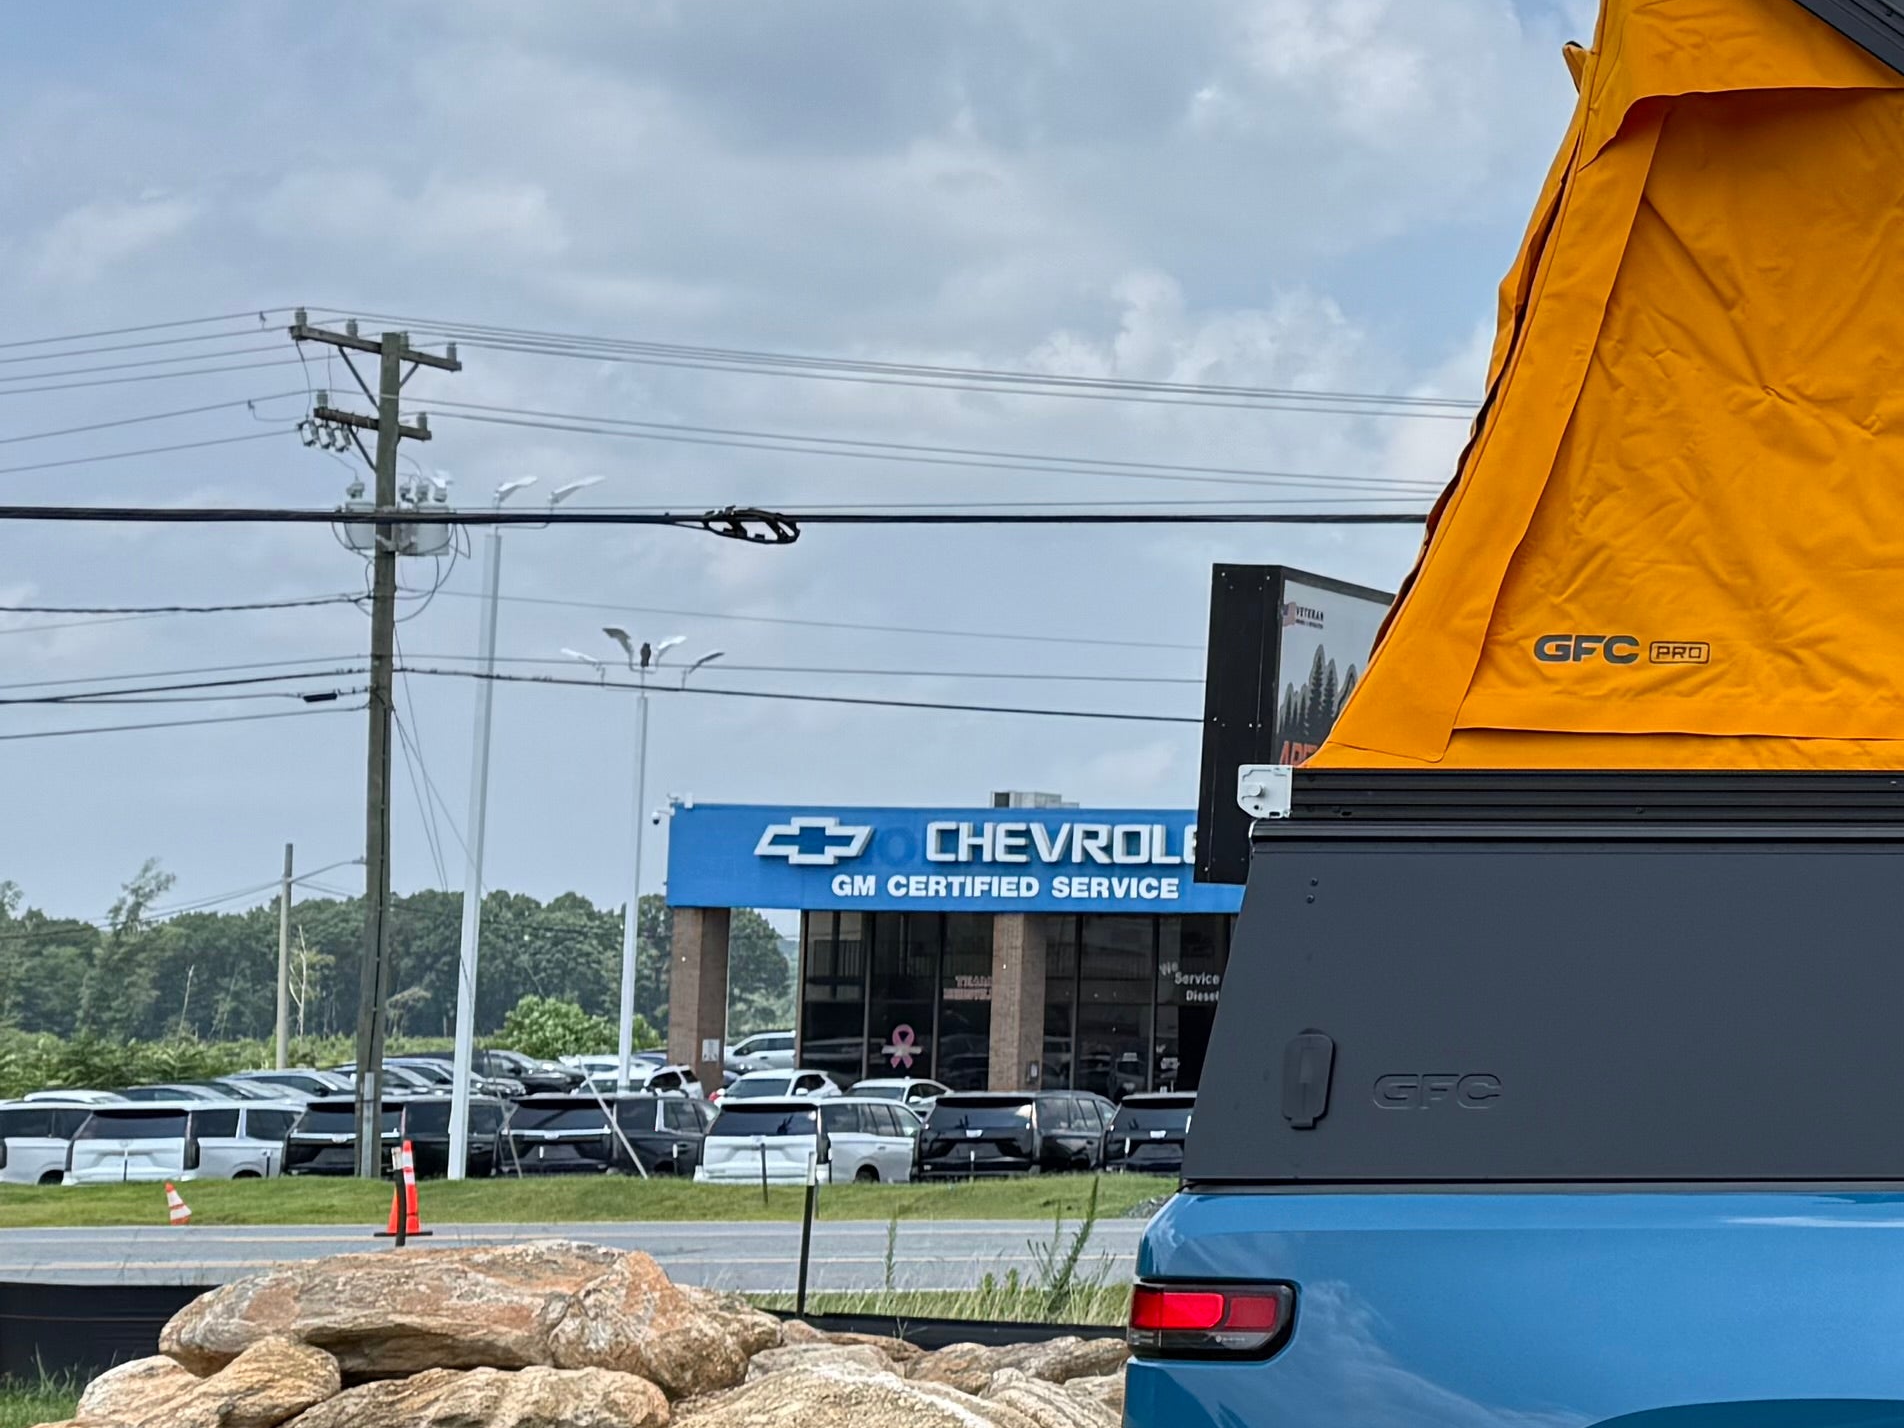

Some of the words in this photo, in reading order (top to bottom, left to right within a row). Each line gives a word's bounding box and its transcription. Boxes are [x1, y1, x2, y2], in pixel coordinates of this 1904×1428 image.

[1533, 634, 1640, 664] GFC
[1655, 644, 1702, 661] PRO
[831, 874, 876, 897] GM
[887, 874, 1039, 898] CERTIFIED
[1051, 876, 1179, 900] SERVICE
[1373, 1073, 1501, 1110] GFC
